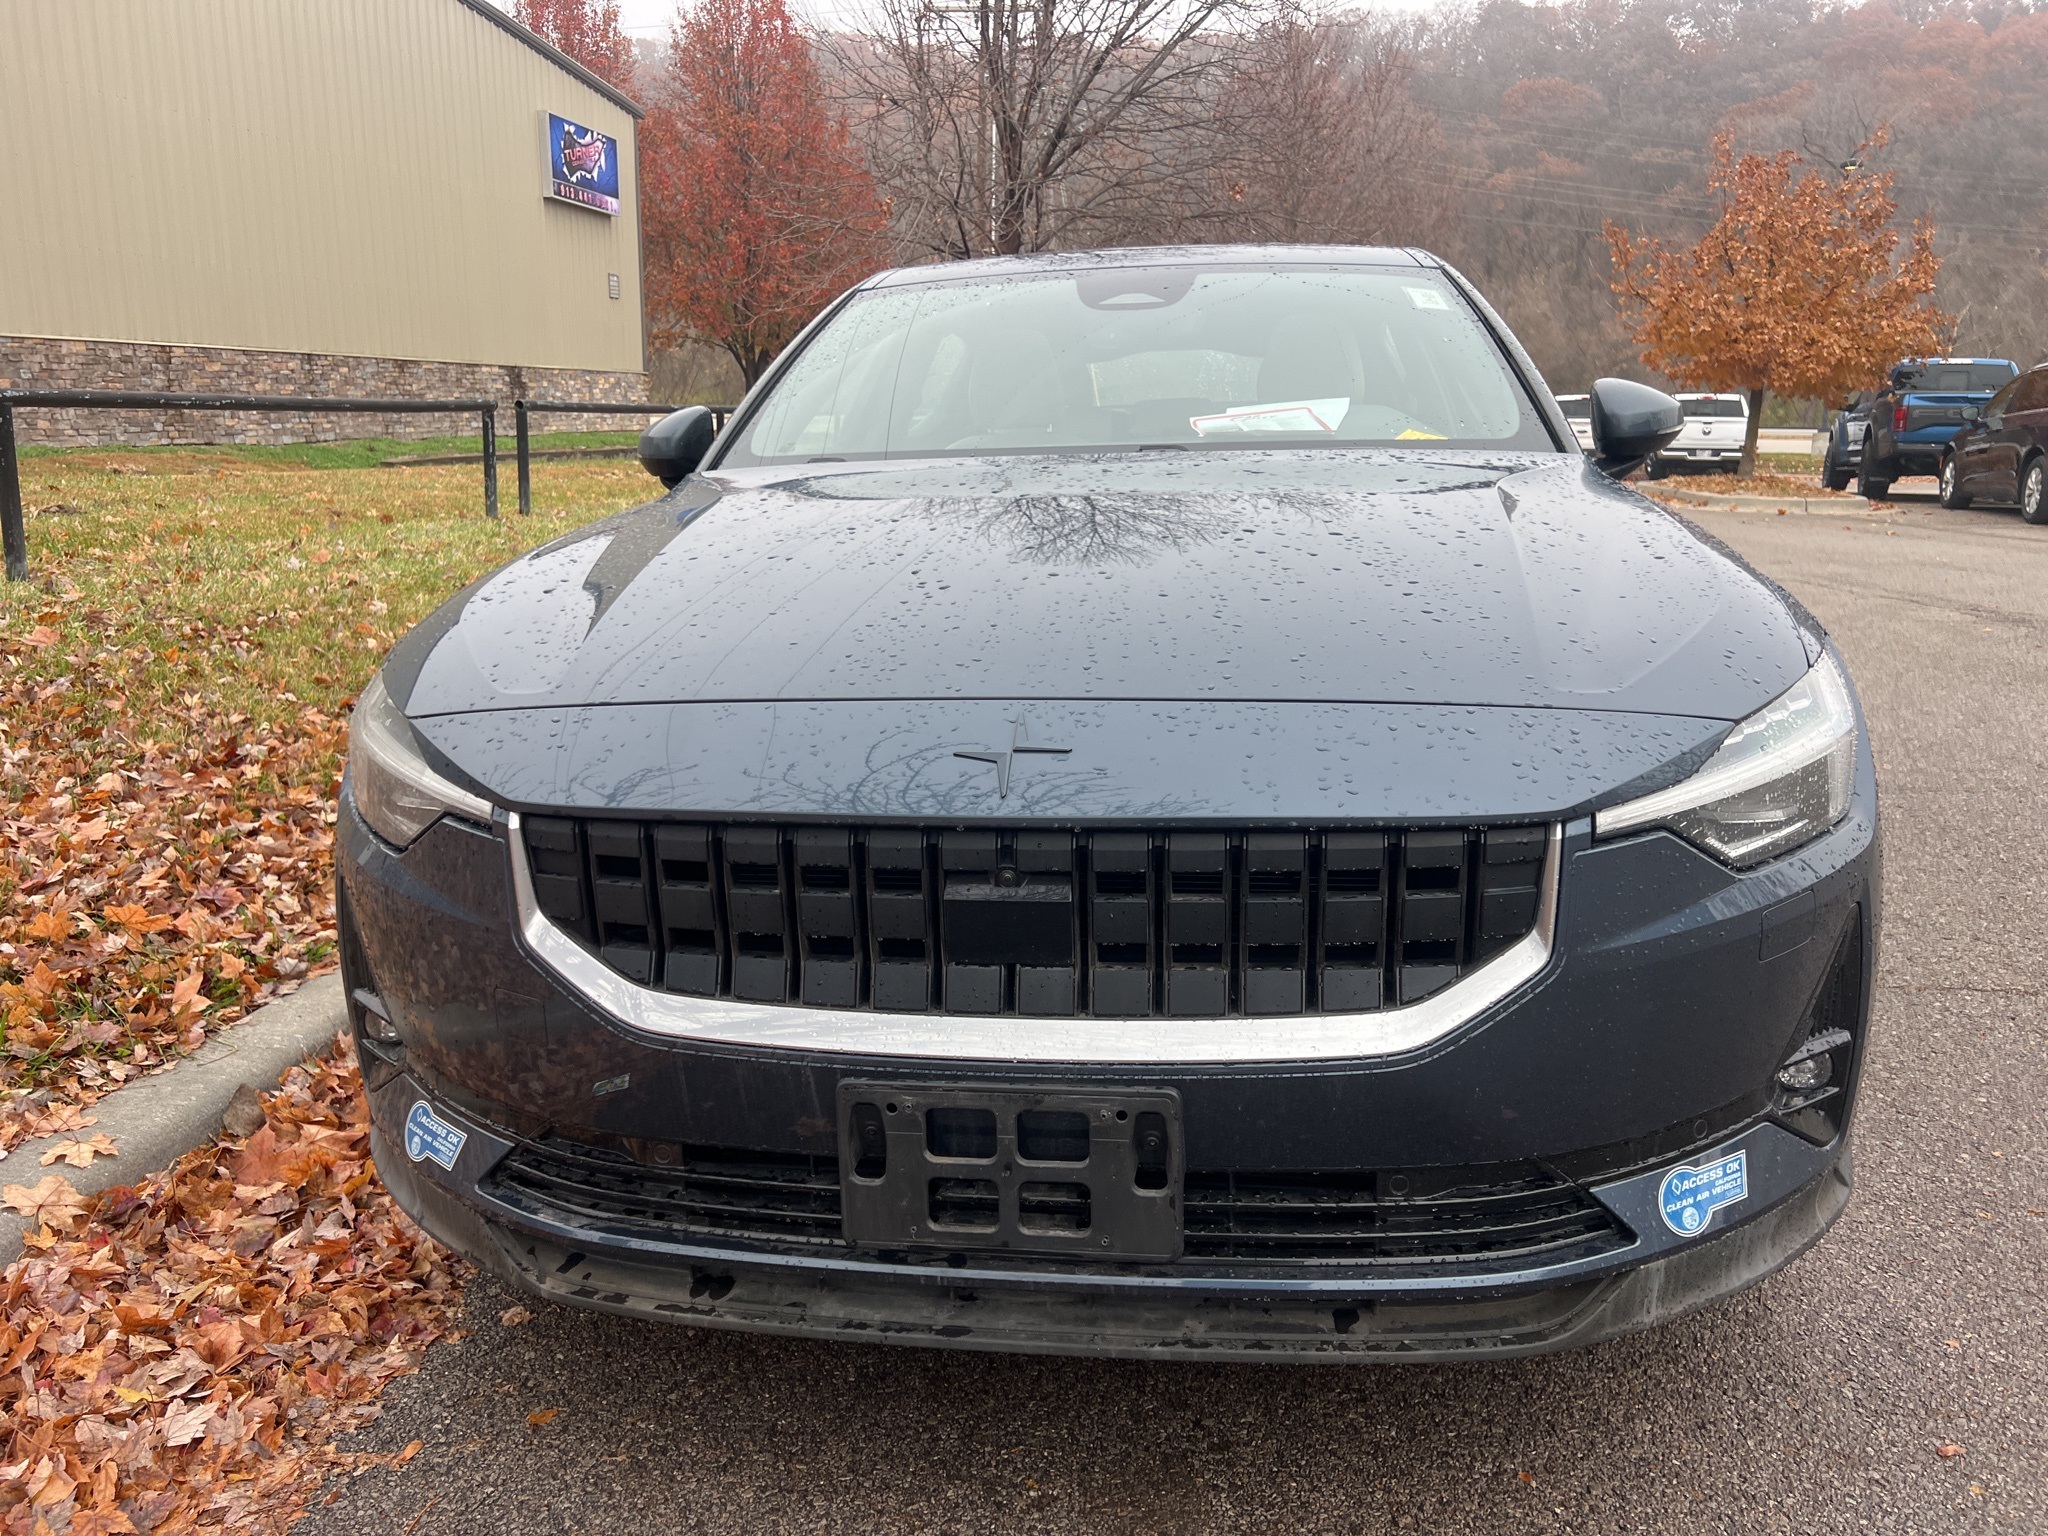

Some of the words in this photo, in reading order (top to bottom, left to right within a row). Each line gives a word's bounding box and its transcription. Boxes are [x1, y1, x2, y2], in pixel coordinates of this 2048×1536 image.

[564, 145, 600, 161] TURNER
[408, 1122, 424, 1137] CLEAN
[423, 1134, 433, 1143] AIR
[432, 1139, 454, 1157] VEHICLE
[421, 1115, 447, 1138] ACCESS
[447, 1133, 461, 1146] OK
[1681, 1167, 1723, 1192] ACCESS
[1726, 1159, 1740, 1174] OK
[1715, 1171, 1741, 1186] CALIFORNIA
[1666, 1196, 1693, 1213] CLEAN
[1696, 1190, 1710, 1202] AIR
[1711, 1177, 1741, 1195] VEHICLE
